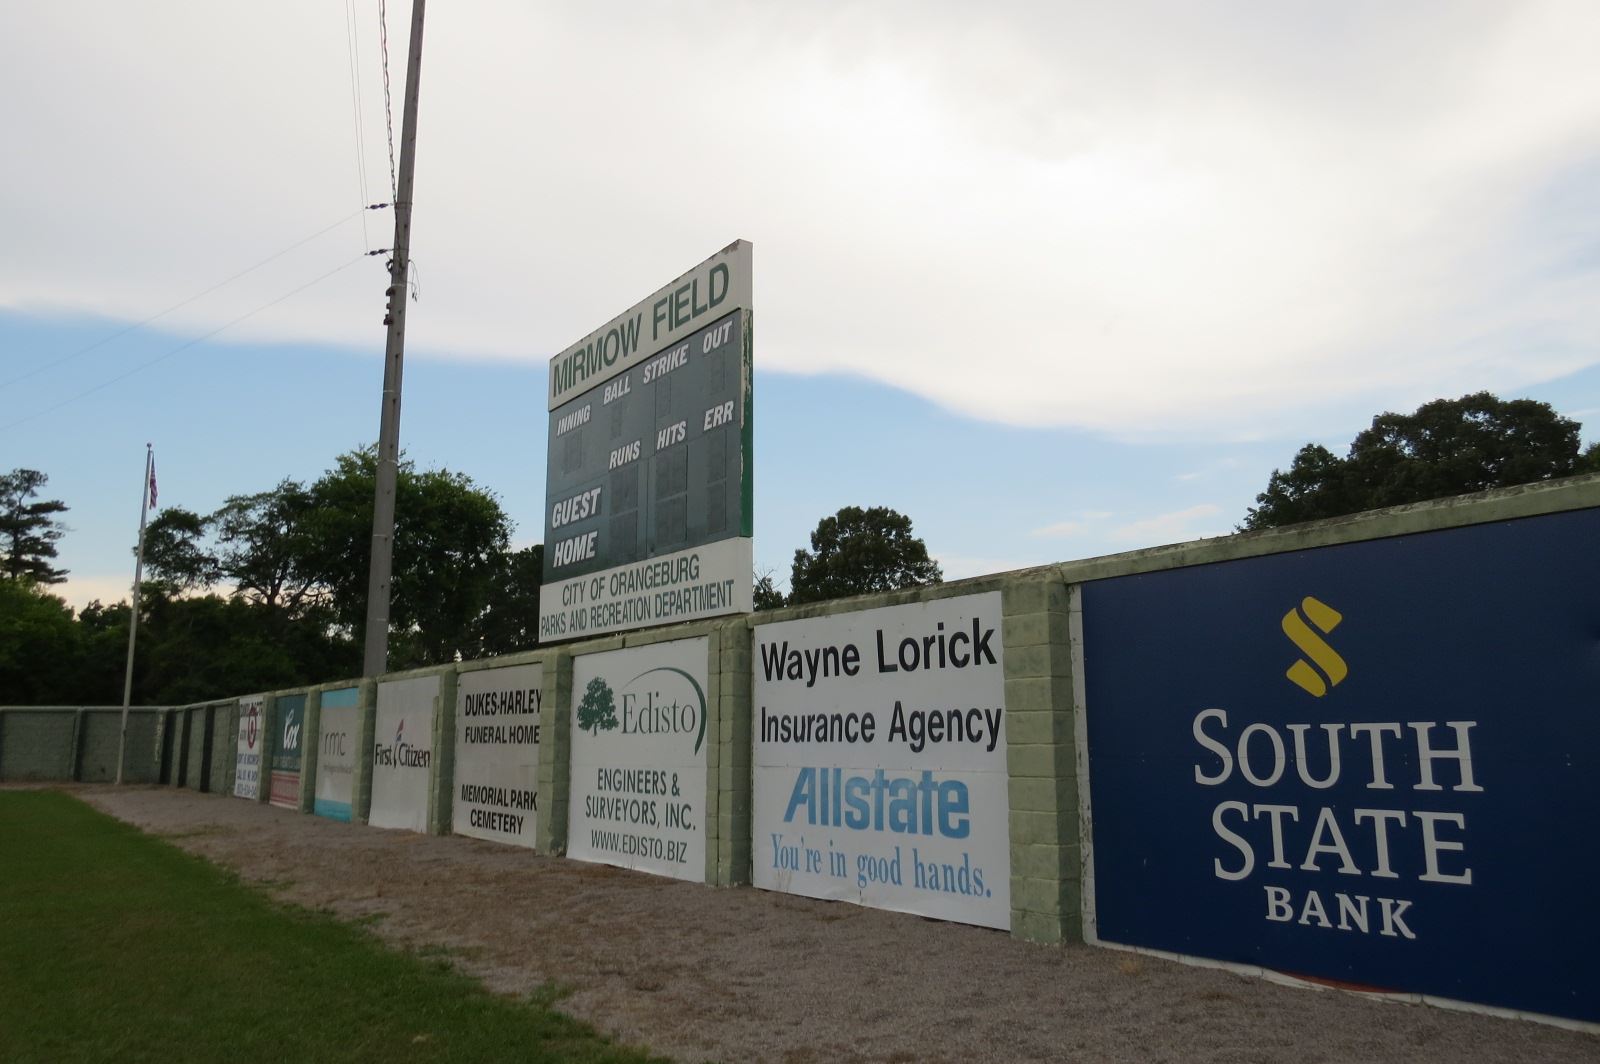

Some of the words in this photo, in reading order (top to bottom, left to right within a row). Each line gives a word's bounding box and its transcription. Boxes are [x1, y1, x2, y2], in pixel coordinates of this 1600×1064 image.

[553, 313, 642, 398] MIRMOW
[652, 262, 729, 341] FIELD
[557, 404, 591, 436] INNING
[603, 376, 631, 405] BALL
[643, 344, 689, 384] STRIKE
[702, 321, 732, 354] OUT
[609, 441, 641, 470] RUNS
[656, 420, 687, 450] HITS
[703, 400, 735, 431] ERR
[552, 487, 602, 529] GUEST
[553, 531, 598, 568] HOME
[562, 583, 586, 607] CITY
[590, 574, 606, 600] OF
[610, 554, 700, 597] ORANGEBURG
[541, 610, 567, 637] PARKS
[569, 605, 587, 633] AND
[590, 596, 651, 629] RECREATION
[655, 579, 734, 618] DEPARTMENT
[760, 640, 861, 688] Wayne
[876, 617, 998, 673] Lorick
[465, 725, 507, 745] FUNERAL
[509, 725, 540, 745] HOME
[621, 690, 697, 735] Edisto
[761, 706, 876, 744] Insurance
[888, 700, 1002, 753] Agency
[374, 743, 392, 767] First
[461, 784, 509, 808] MEMORIAL
[510, 790, 538, 812] PARK
[597, 768, 667, 797] ENGINEERS
[671, 772, 681, 797] &
[783, 766, 971, 840] Allstate
[470, 809, 524, 835] CEMETERY
[585, 795, 660, 830] SURVEYORS,
[665, 802, 697, 832] INC.
[590, 829, 688, 864] WWW.EDISTO.BIZ
[771, 833, 822, 874] You're
[830, 839, 848, 878] in
[857, 846, 903, 889] good
[913, 848, 992, 898] hands.
